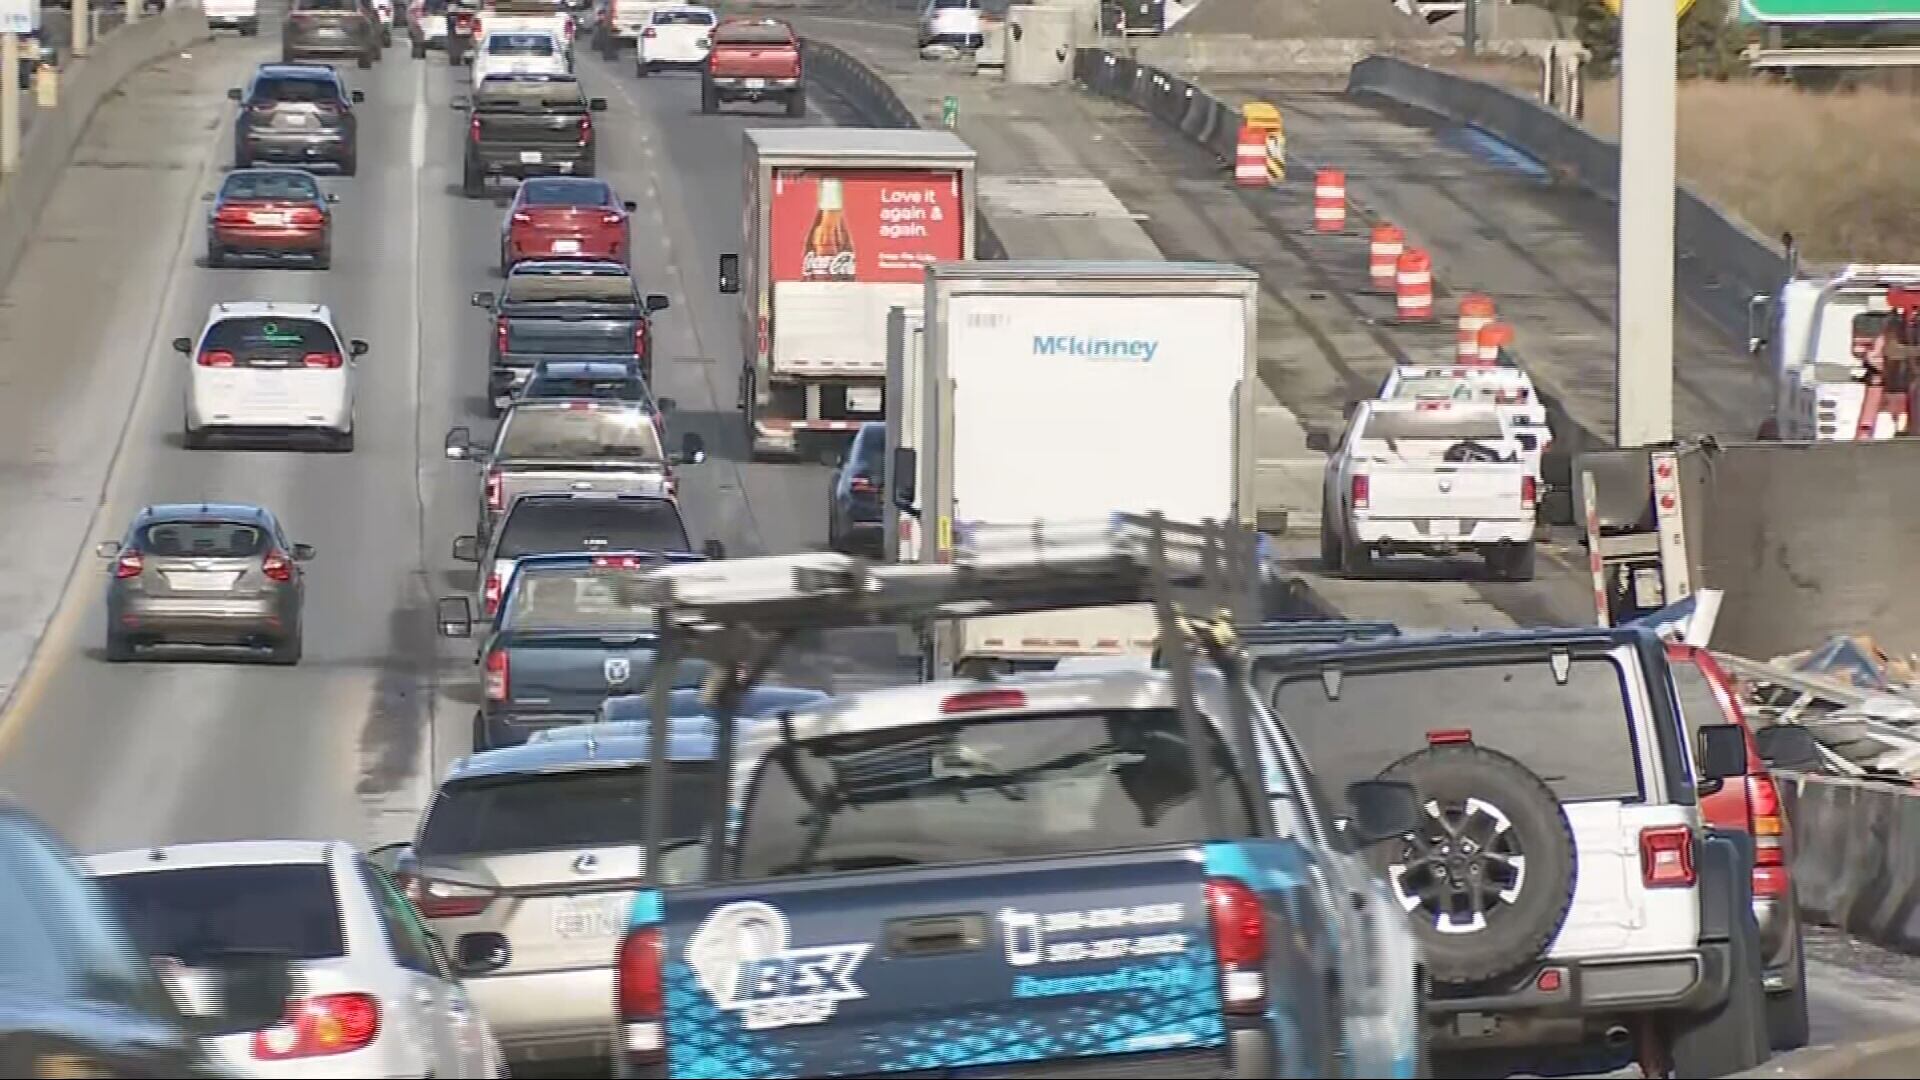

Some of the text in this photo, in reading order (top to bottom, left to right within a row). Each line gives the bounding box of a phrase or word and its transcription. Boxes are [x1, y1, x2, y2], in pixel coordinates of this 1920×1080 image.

[881, 188, 936, 204] Love it
[880, 206, 943, 222] again &
[732, 952, 857, 1001] IBEX
